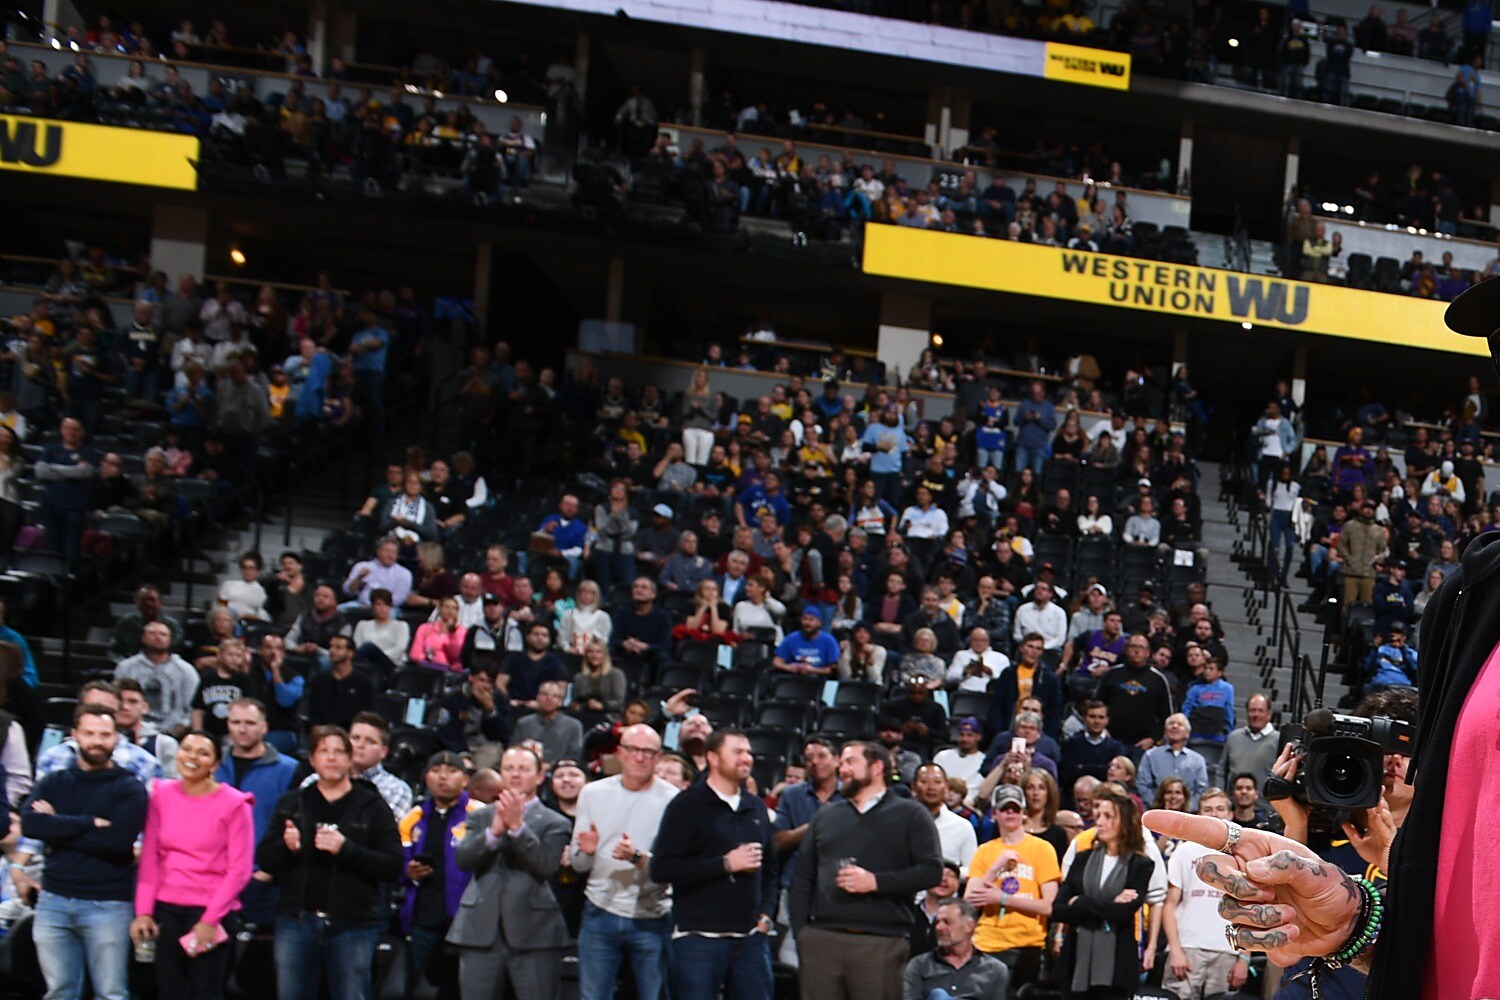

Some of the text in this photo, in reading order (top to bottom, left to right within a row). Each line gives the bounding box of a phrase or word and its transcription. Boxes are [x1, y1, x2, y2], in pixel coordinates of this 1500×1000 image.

[1061, 252, 1216, 292] WESTERN
[1109, 273, 1310, 325] UNION WU
